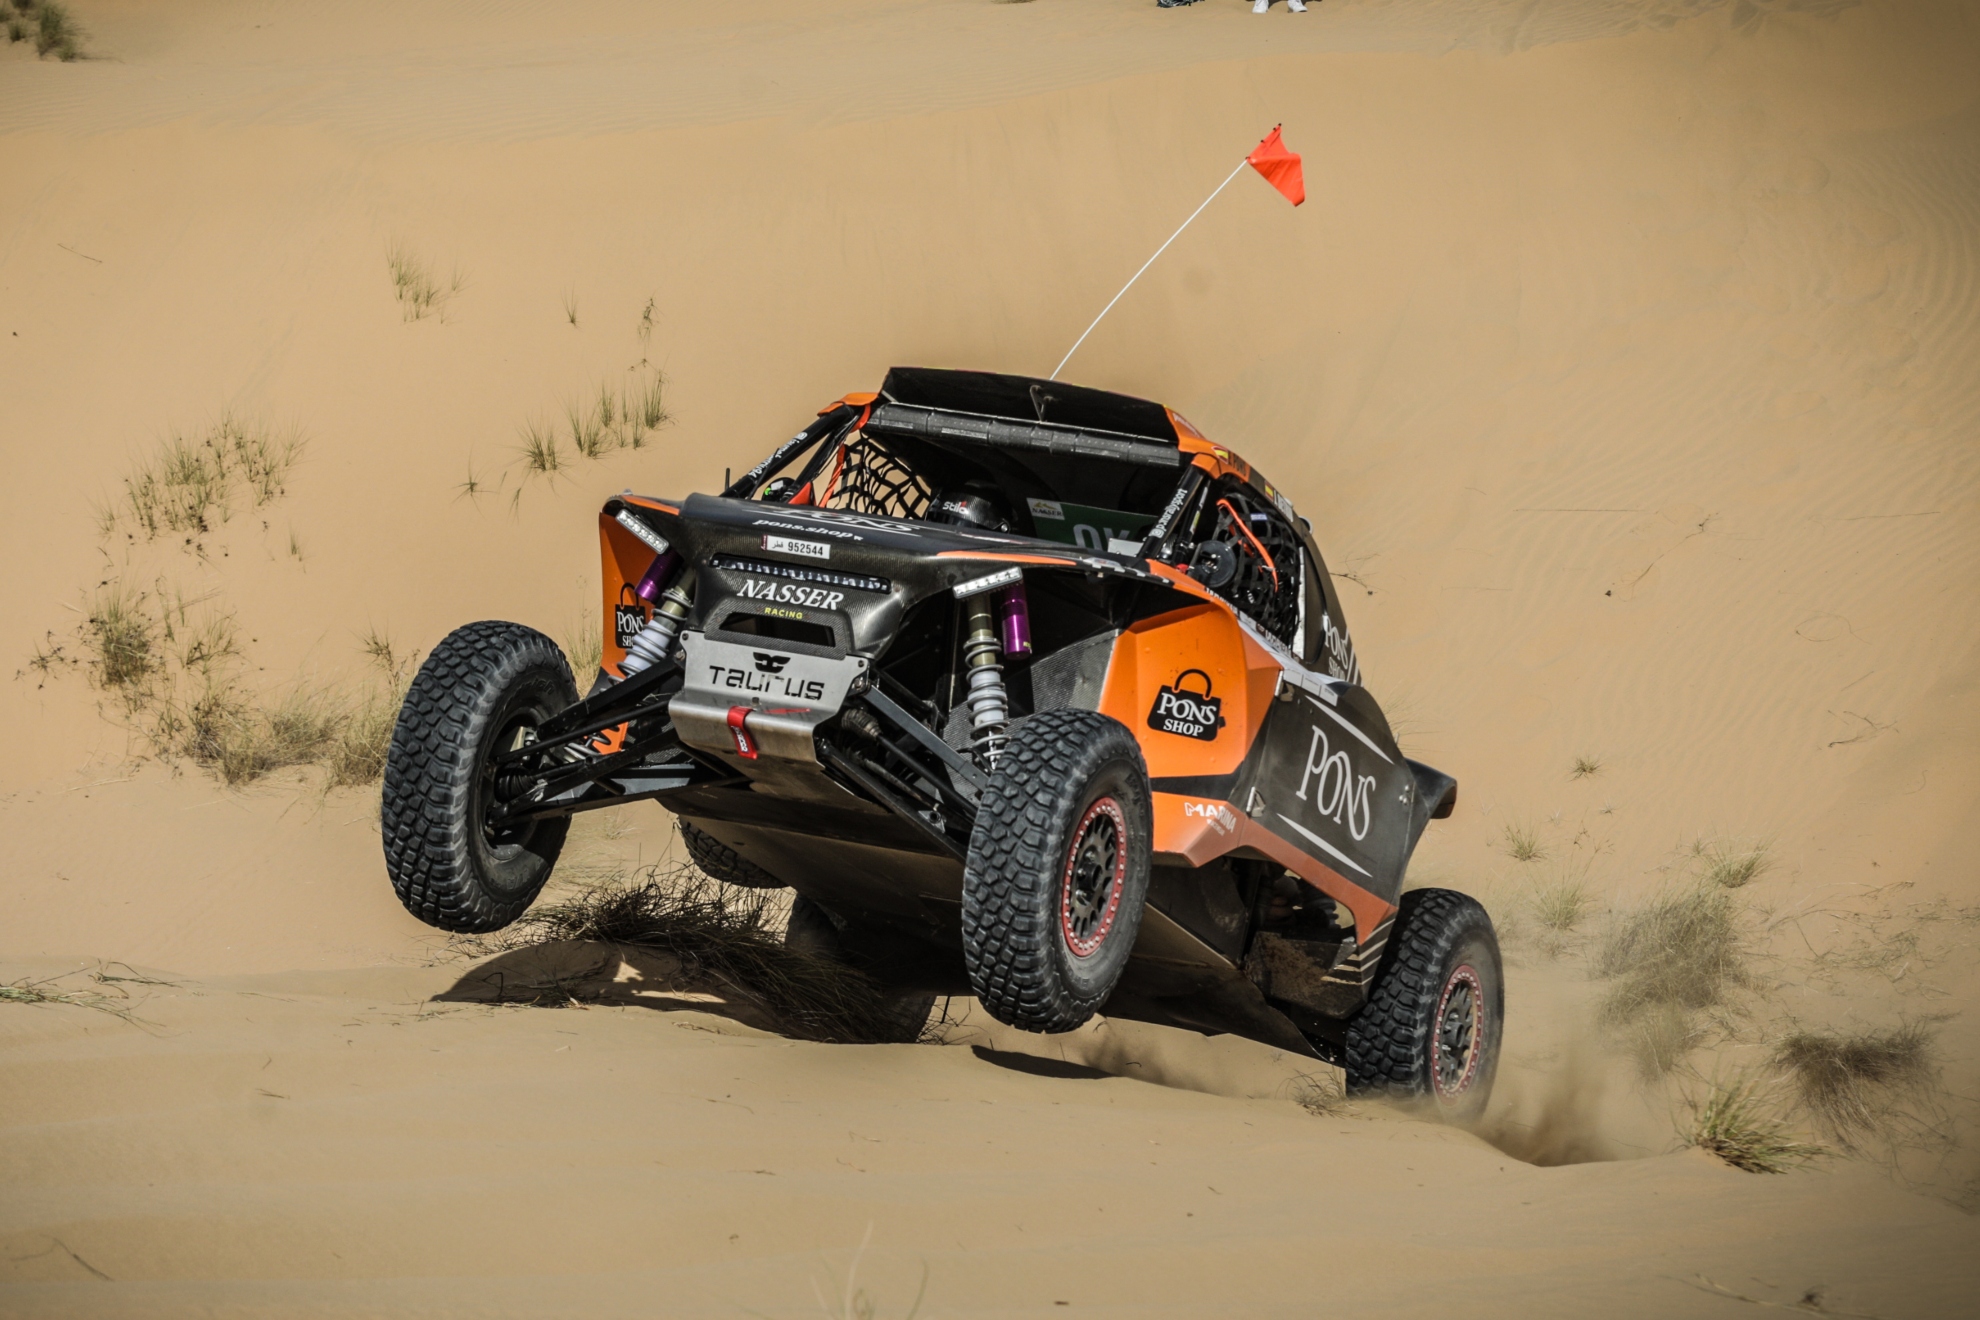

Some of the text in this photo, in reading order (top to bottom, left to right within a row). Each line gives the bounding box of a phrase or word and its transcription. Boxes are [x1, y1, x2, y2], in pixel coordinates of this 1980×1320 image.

[752, 519, 854, 538] pons.shop
[788, 541, 824, 556] 952544
[737, 579, 844, 610] NASSER
[764, 607, 803, 619] RACING
[622, 635, 634, 647] SH
[1156, 692, 1218, 725] PONS
[1162, 718, 1204, 737] SHOP
[1295, 725, 1376, 841] PONS
[1184, 802, 1237, 833] MARINA
